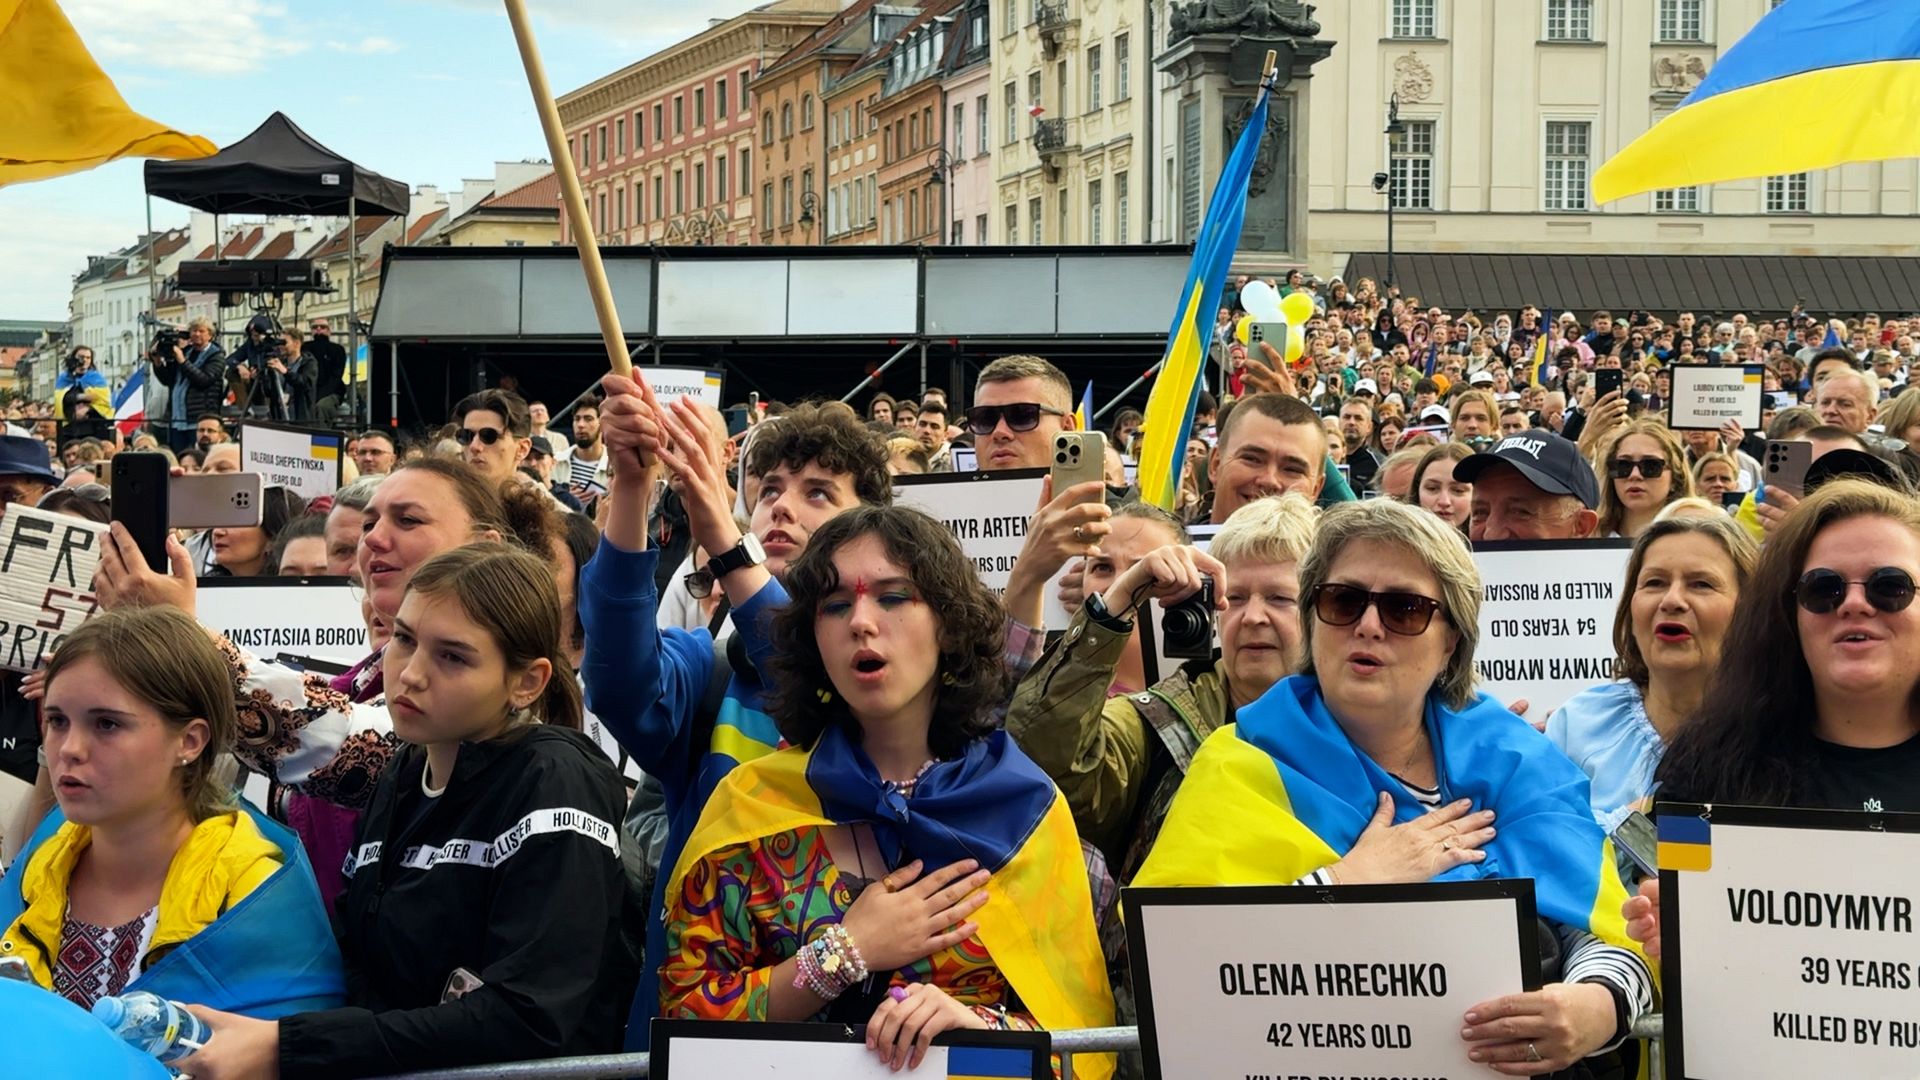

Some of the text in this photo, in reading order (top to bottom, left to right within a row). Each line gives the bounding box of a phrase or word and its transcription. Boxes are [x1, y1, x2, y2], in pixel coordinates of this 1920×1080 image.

[1494, 436, 1547, 460] EVERLAST
[275, 455, 325, 472] SHEPETYNSKA
[270, 473, 289, 486] YEARS
[289, 476, 303, 487] OLD
[941, 518, 979, 539] MYR
[1, 515, 95, 592] FR
[1543, 583, 1561, 600] BY
[1565, 582, 1613, 600] KILLED
[223, 628, 311, 646] ANASTASIIA
[1491, 617, 1596, 637] 54 YEARS OLD
[1480, 657, 1612, 681] DYMYR MYRON
[553, 811, 610, 841] HOLLISTER
[1727, 887, 1912, 933] VOLODYMYR
[1219, 963, 1448, 998] OLENA HRECHKO
[1800, 956, 1830, 985] 39
[1836, 958, 1911, 990] YEARS
[1266, 1022, 1412, 1049] 42 YEARS OLD
[1773, 1012, 1920, 1049] KILLED BY RU
